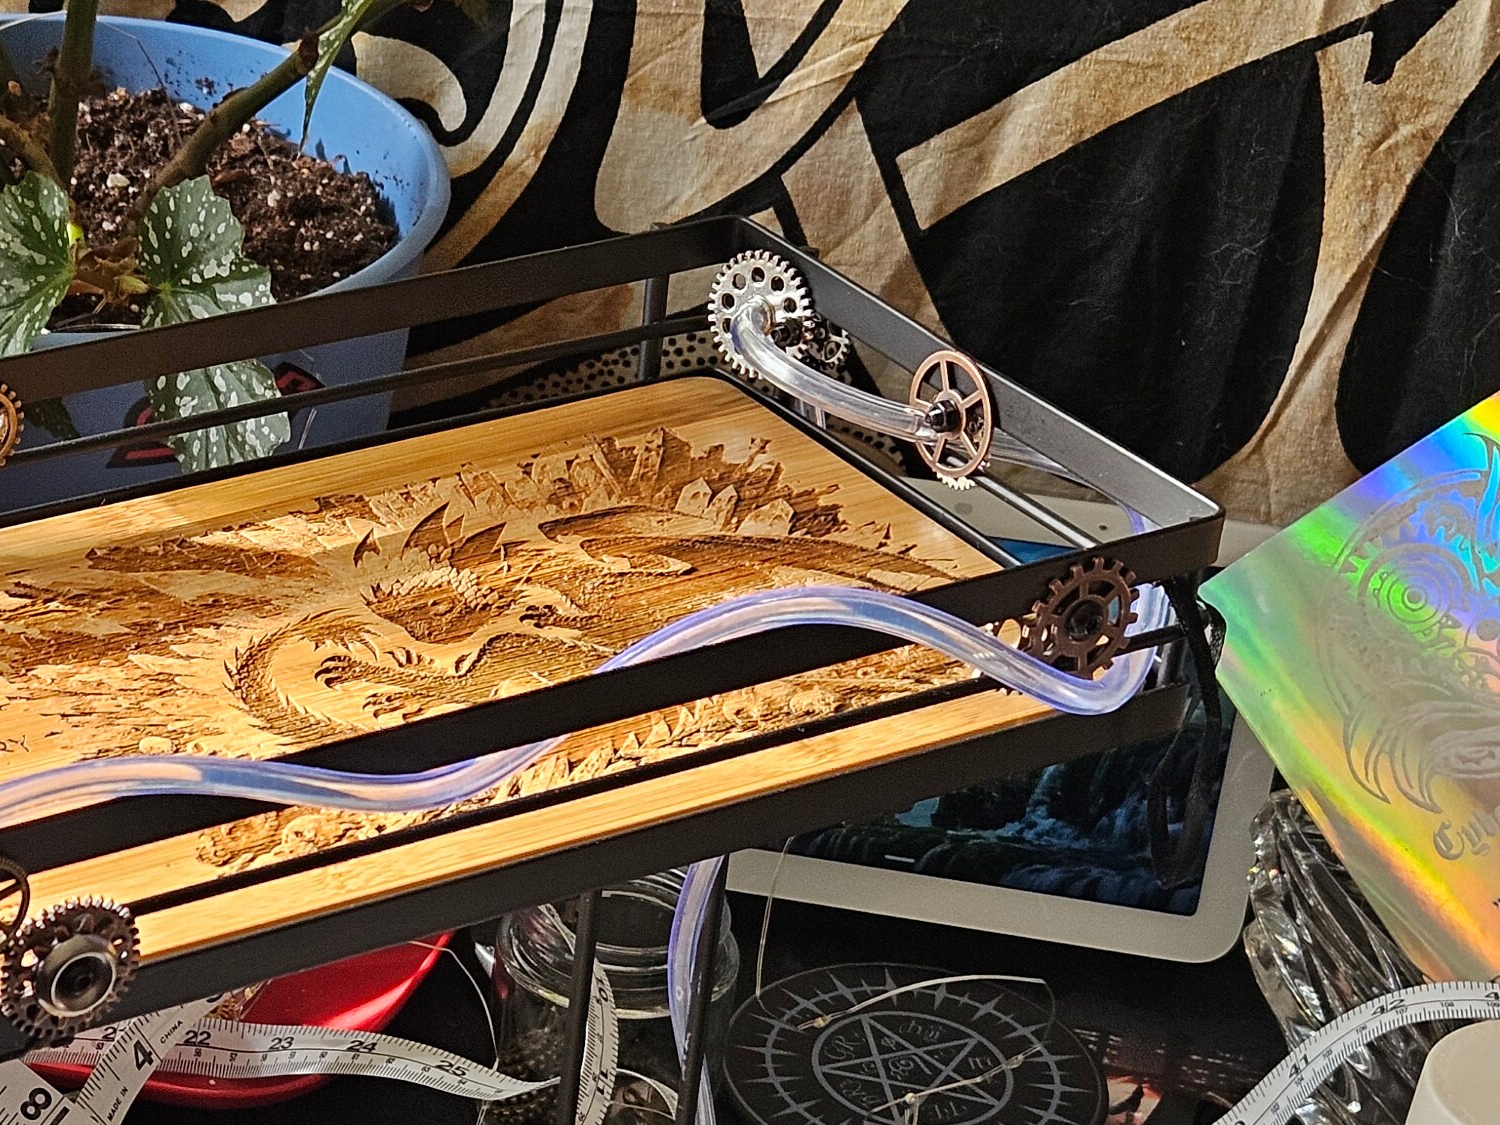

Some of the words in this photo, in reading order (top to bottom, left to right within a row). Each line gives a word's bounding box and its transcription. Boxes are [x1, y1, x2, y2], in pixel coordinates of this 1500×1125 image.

[1371, 999, 1405, 1016] 42
[159, 1019, 184, 1044] CHINA
[185, 1030, 212, 1045] 22
[269, 1036, 294, 1050] 23
[347, 1040, 377, 1052] 24
[133, 1039, 155, 1071] 4
[434, 1060, 470, 1077] 25
[1288, 1053, 1309, 1079] 41
[107, 1096, 122, 1121] MADE
[121, 1086, 128, 1097] IN
